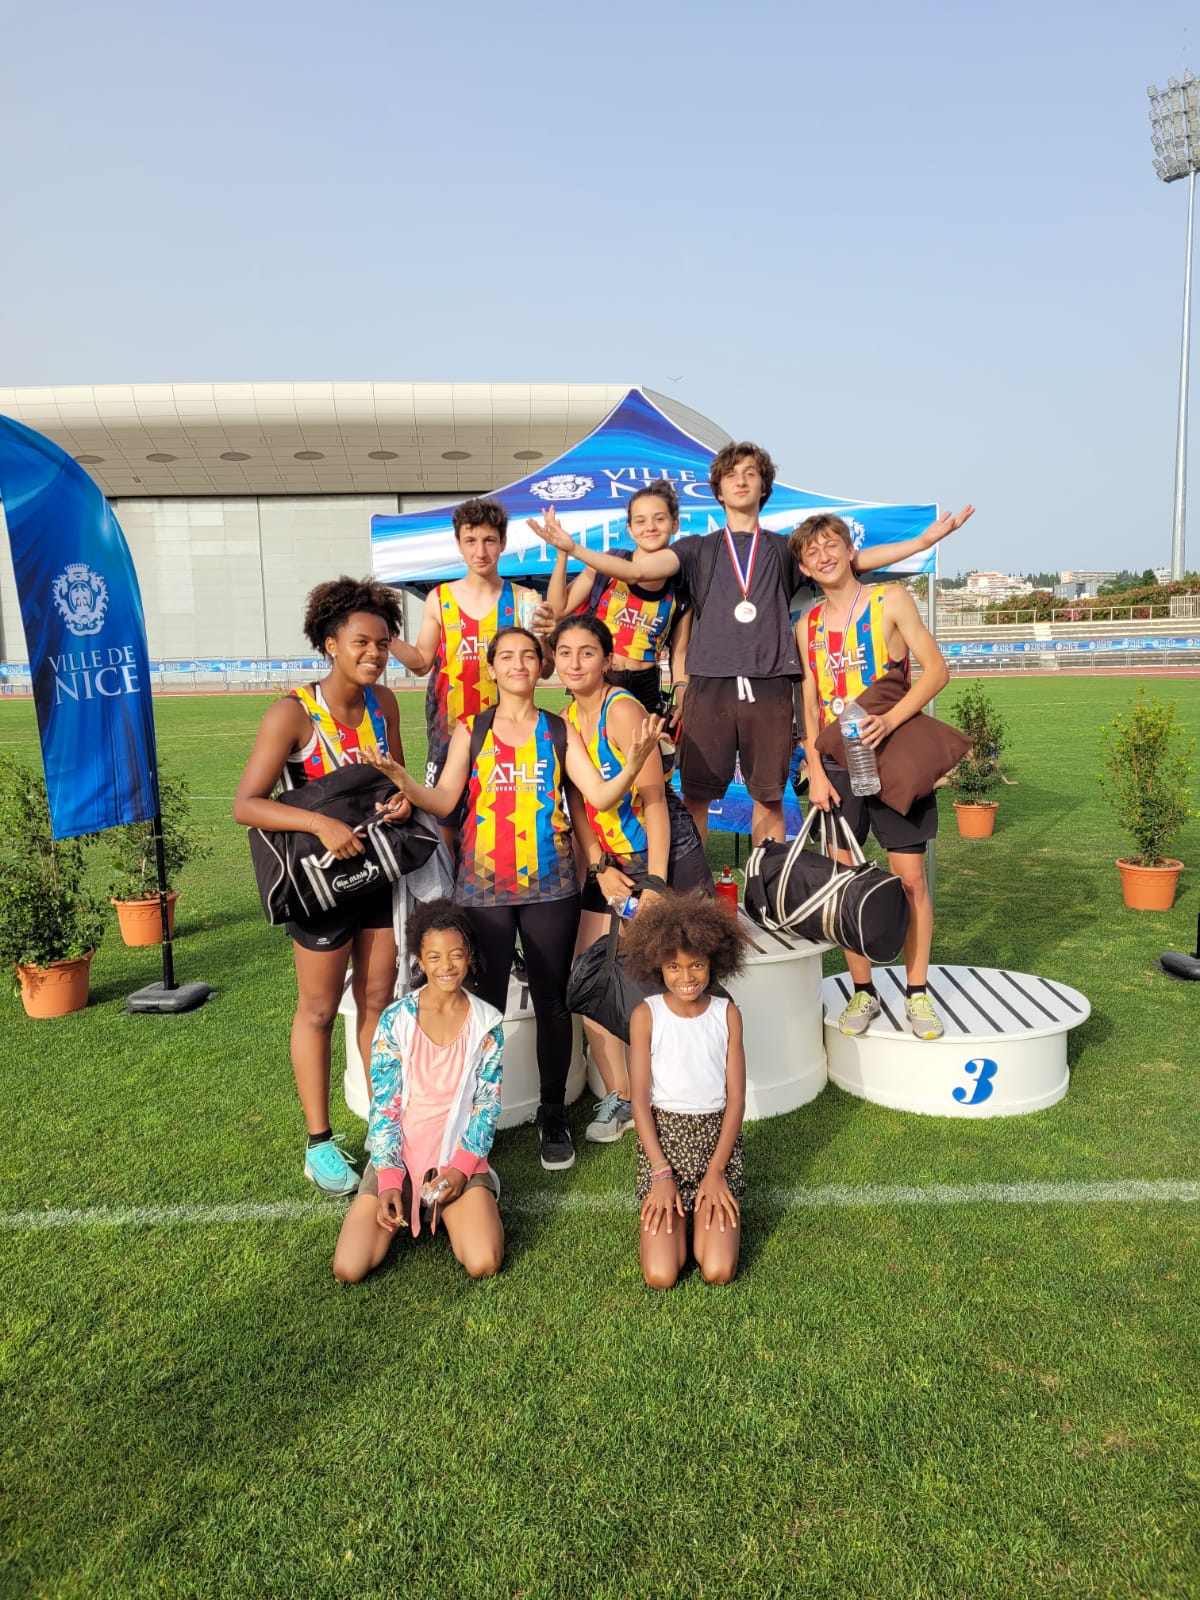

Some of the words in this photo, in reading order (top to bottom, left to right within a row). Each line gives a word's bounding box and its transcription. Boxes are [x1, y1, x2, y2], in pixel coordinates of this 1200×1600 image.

[601, 467, 697, 482] VILLE
[456, 635, 489, 656] ATH
[48, 650, 103, 673] VILLE
[107, 645, 136, 666] DE
[55, 664, 141, 705] NICE
[487, 759, 547, 784] ATHLÉ
[951, 1058, 998, 1105] 3
